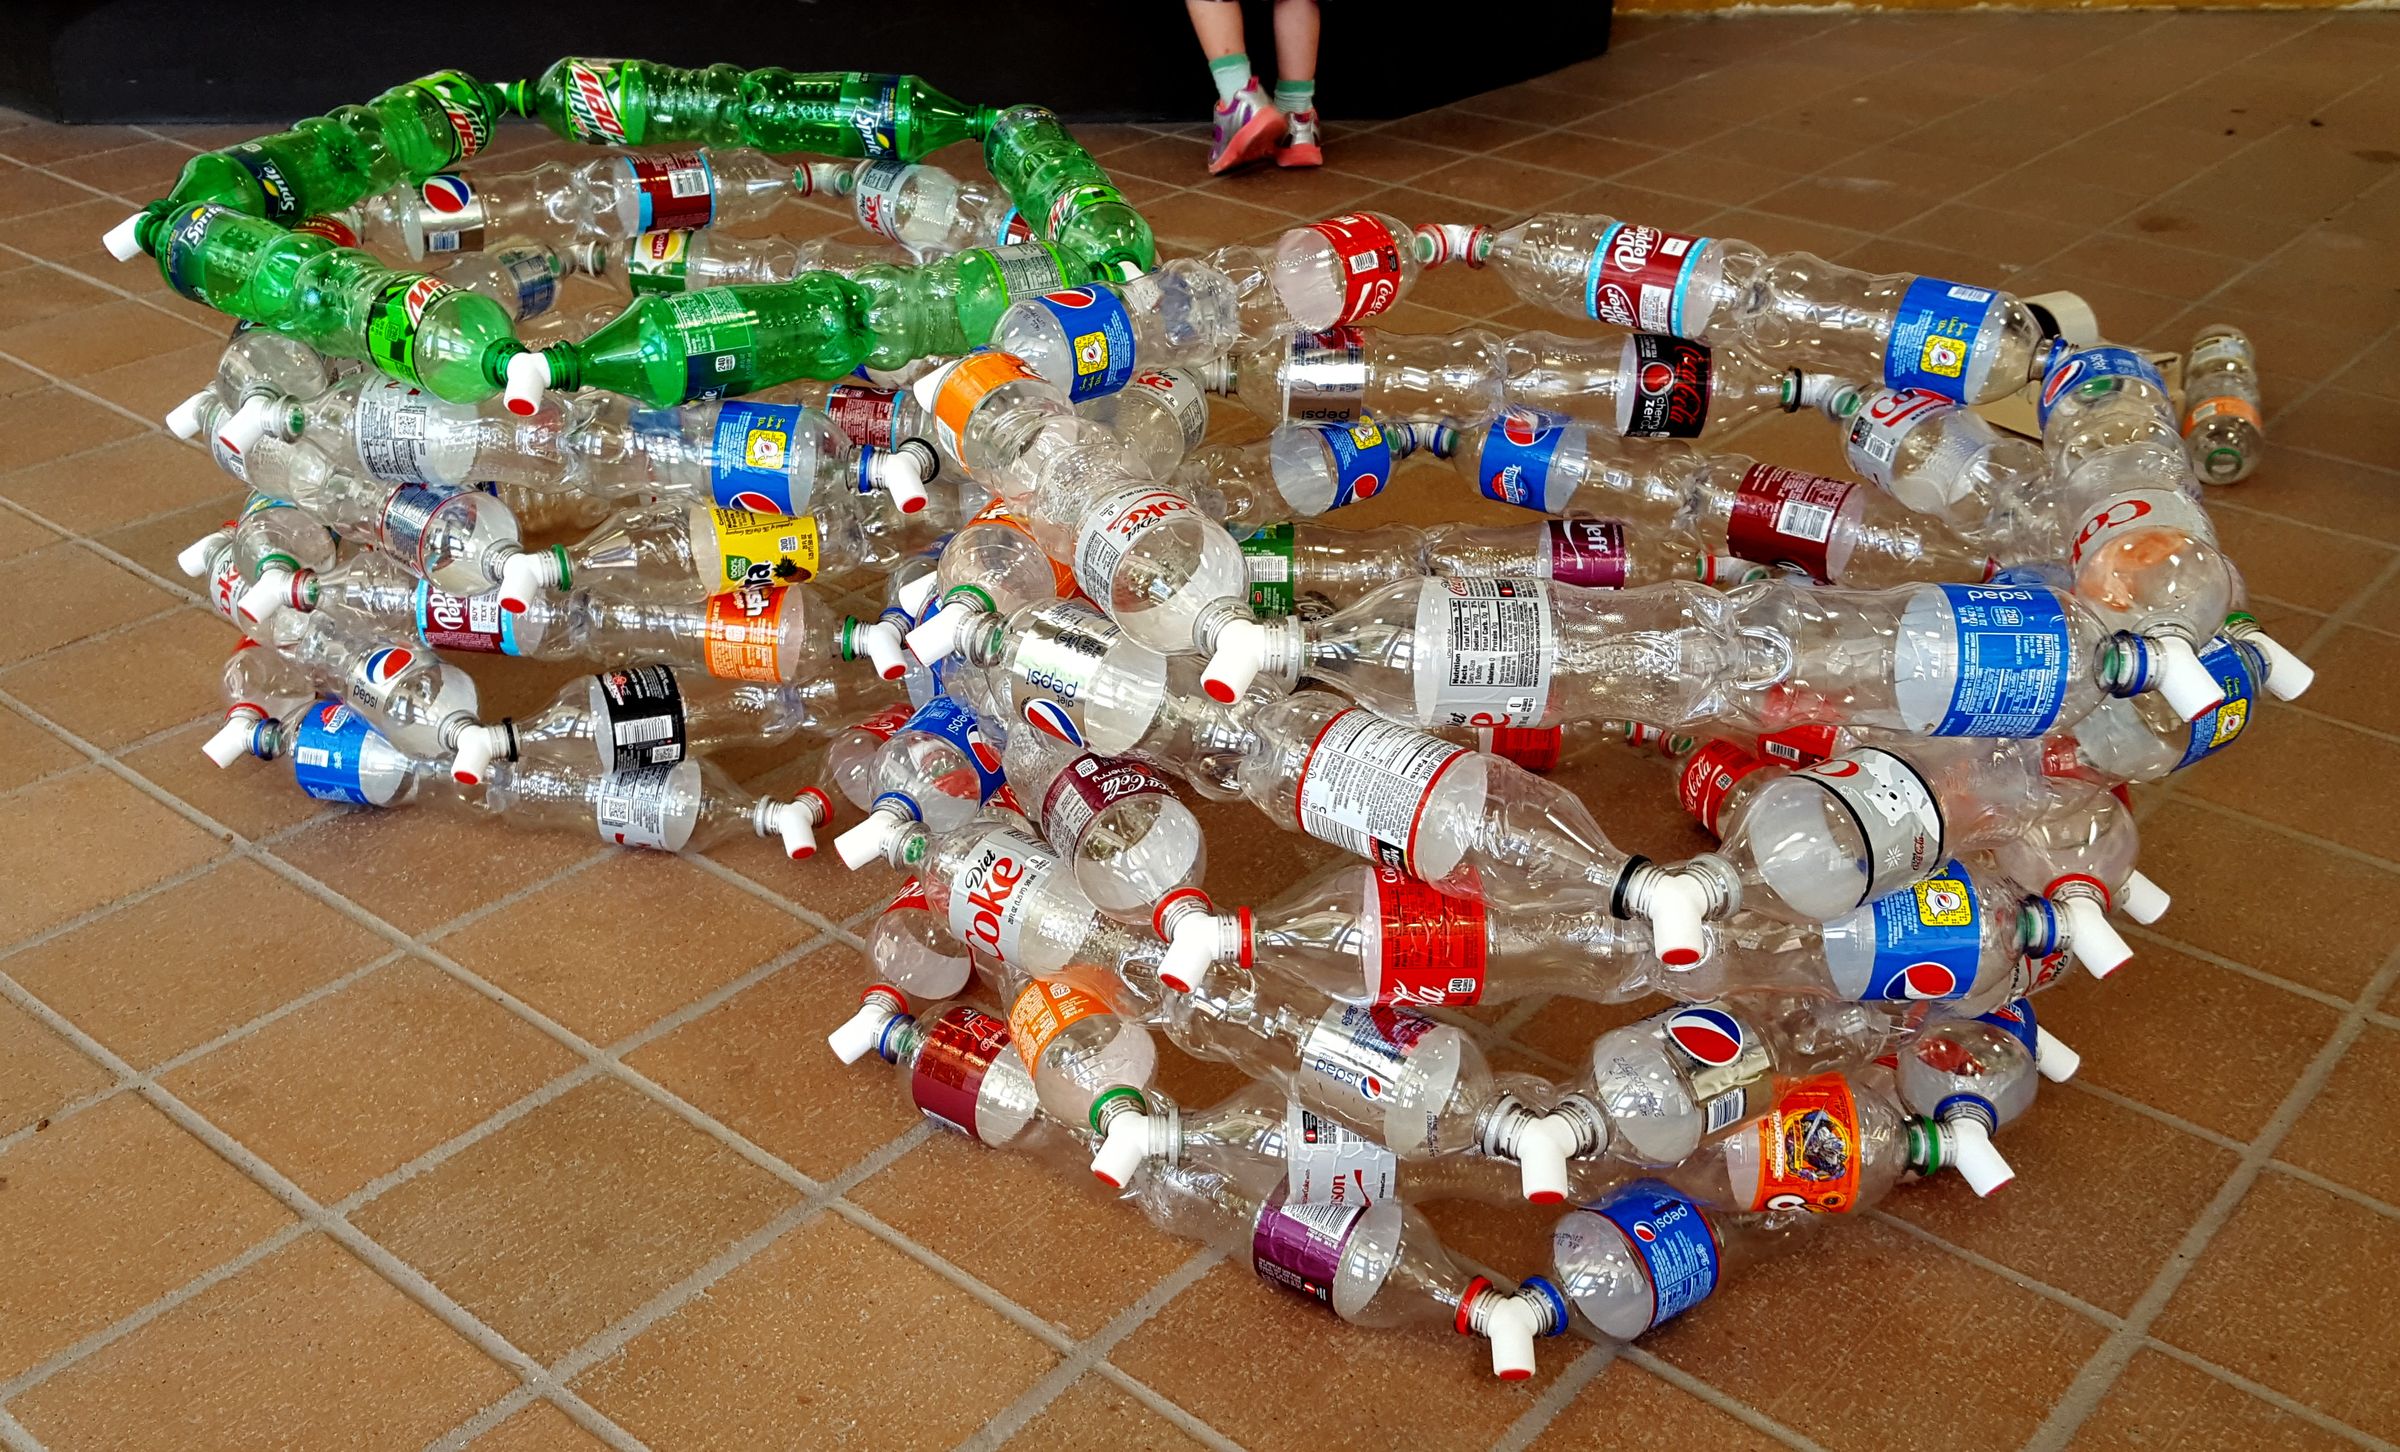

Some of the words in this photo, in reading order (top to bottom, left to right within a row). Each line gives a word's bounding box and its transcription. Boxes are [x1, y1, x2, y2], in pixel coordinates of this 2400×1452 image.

[263, 165, 296, 212] Sprite
[717, 357, 726, 372] 240
[1301, 409, 1350, 421] pepsi
[1641, 400, 1655, 430] zero
[1654, 396, 1666, 429] cherry
[1120, 501, 1189, 534] oke
[1126, 517, 1161, 542] Diet
[780, 538, 789, 551] 300
[1580, 522, 1610, 554] Jeff
[730, 558, 738, 579] 100%
[1967, 590, 2034, 602] pepsi
[480, 605, 488, 622] TEXT
[2044, 635, 2052, 667] Nutrition
[1452, 653, 1461, 685] Nutrition
[1460, 665, 1468, 685] Facts
[1487, 663, 1495, 685] Calories
[352, 683, 378, 709] pepsi
[1026, 669, 1078, 698] pepsi
[1057, 694, 1074, 708] diet
[1446, 712, 1467, 726] iet
[1092, 767, 1136, 783] cherry
[1410, 759, 1428, 779] Facts
[1421, 761, 1437, 781] JUICE
[965, 849, 996, 889] Diet
[965, 857, 1025, 962] Coke
[1451, 980, 1463, 992] 240
[1314, 1058, 1359, 1087] pepsi
[1772, 1109, 1785, 1180] TRANSFORMERS
[1652, 1204, 1688, 1233] pepsi
